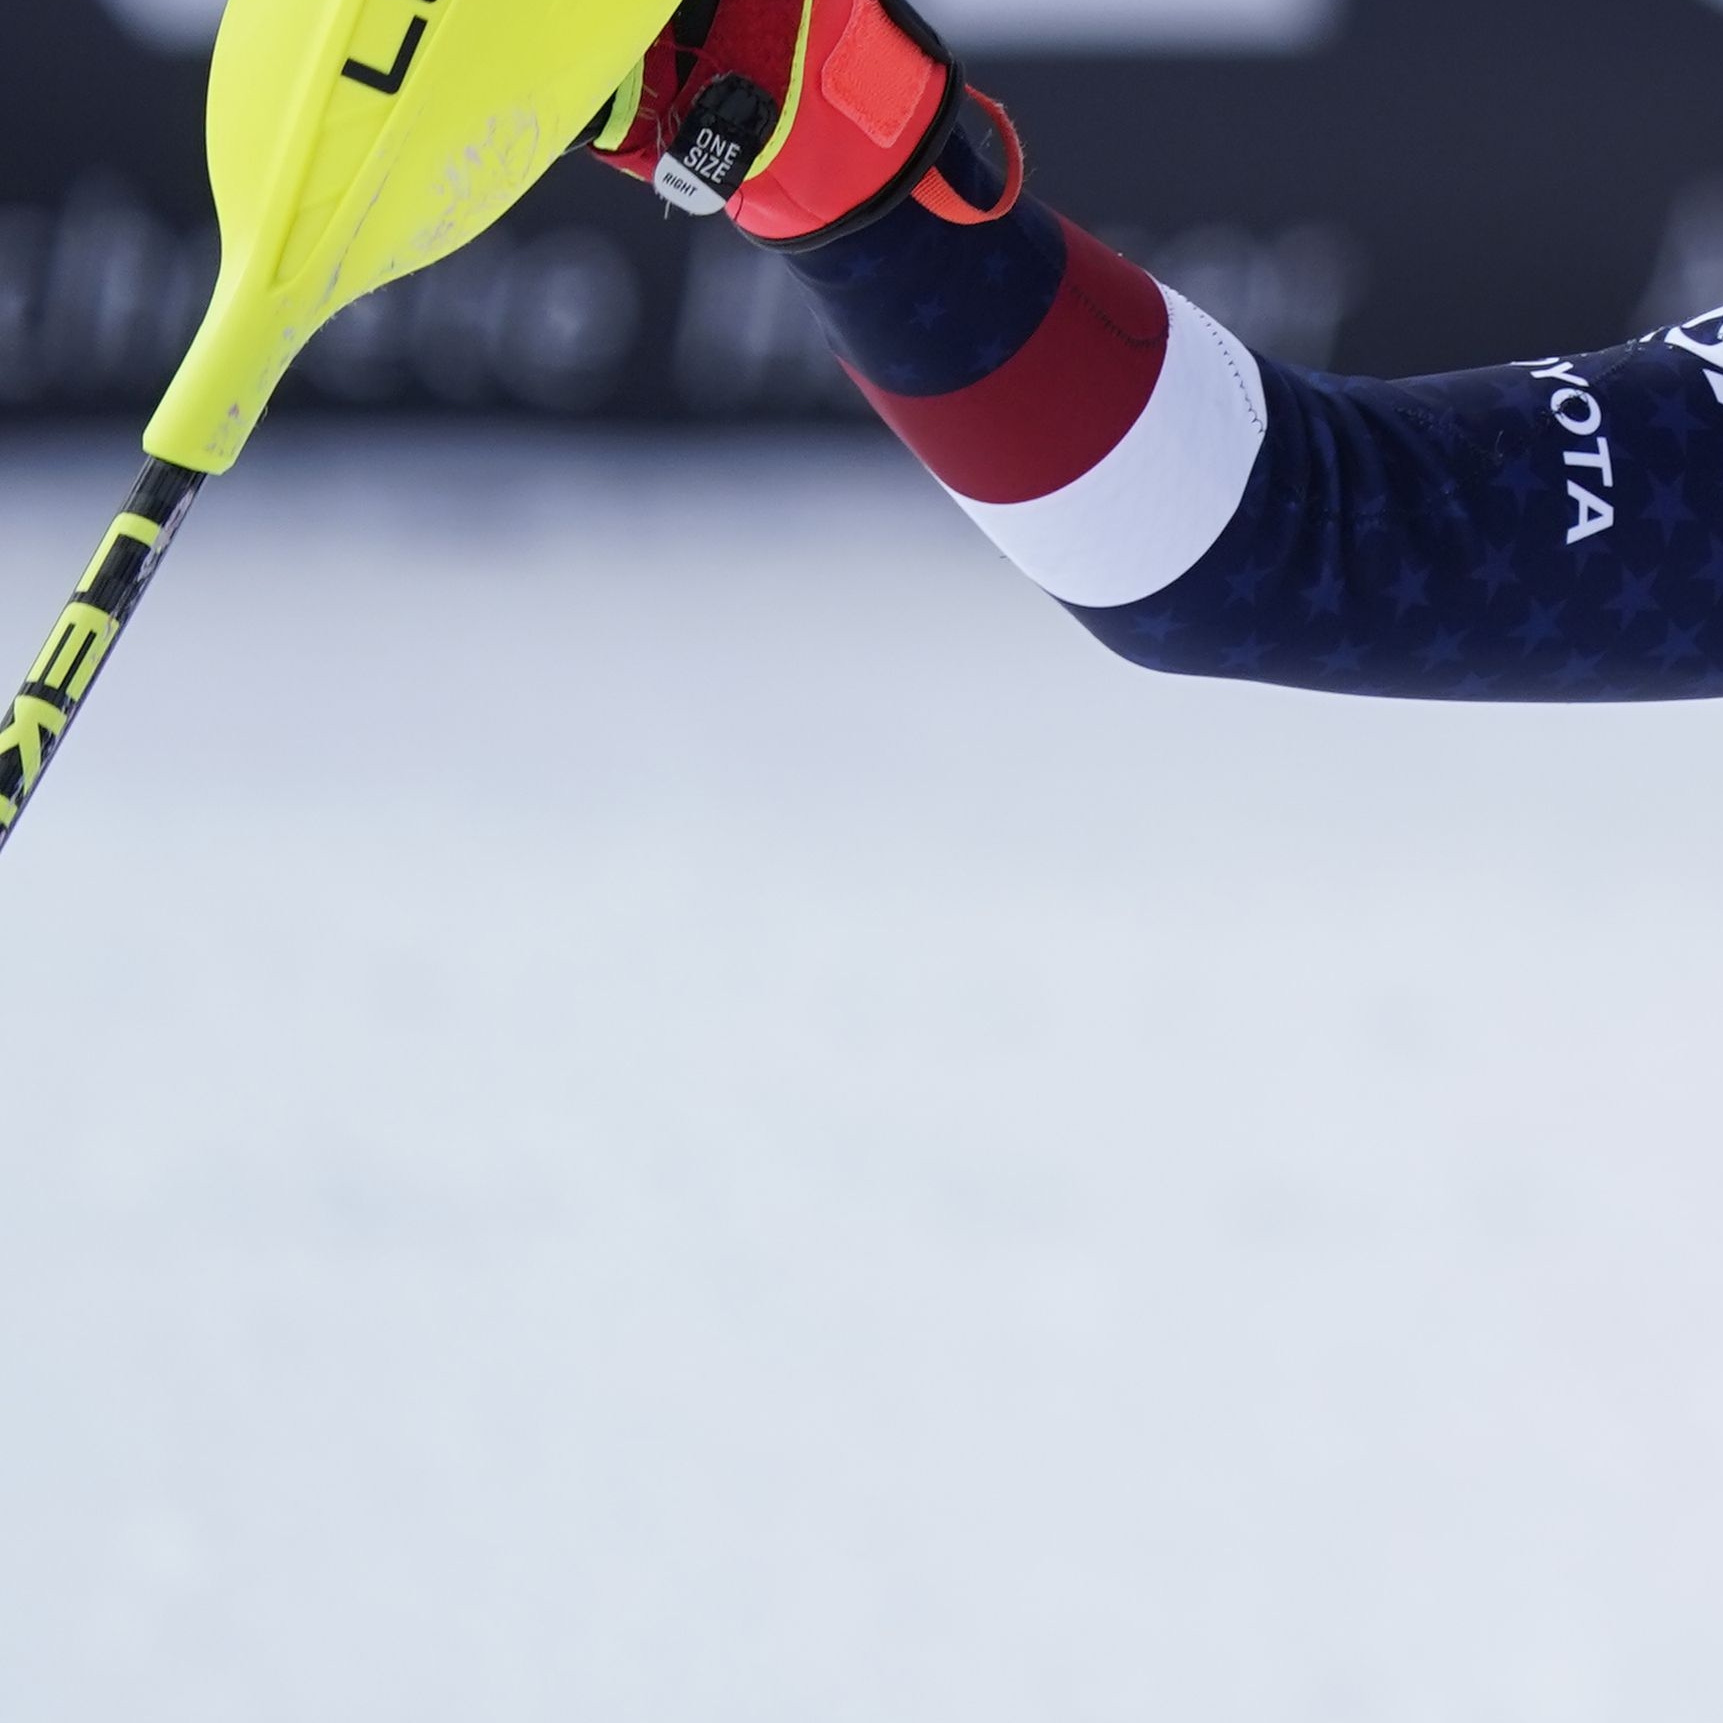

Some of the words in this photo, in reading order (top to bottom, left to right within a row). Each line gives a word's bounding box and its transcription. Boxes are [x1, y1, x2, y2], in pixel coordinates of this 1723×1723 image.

[683, 146, 731, 184] SIZE
[696, 128, 740, 165] ONE
[1511, 357, 1615, 545] YOTA
